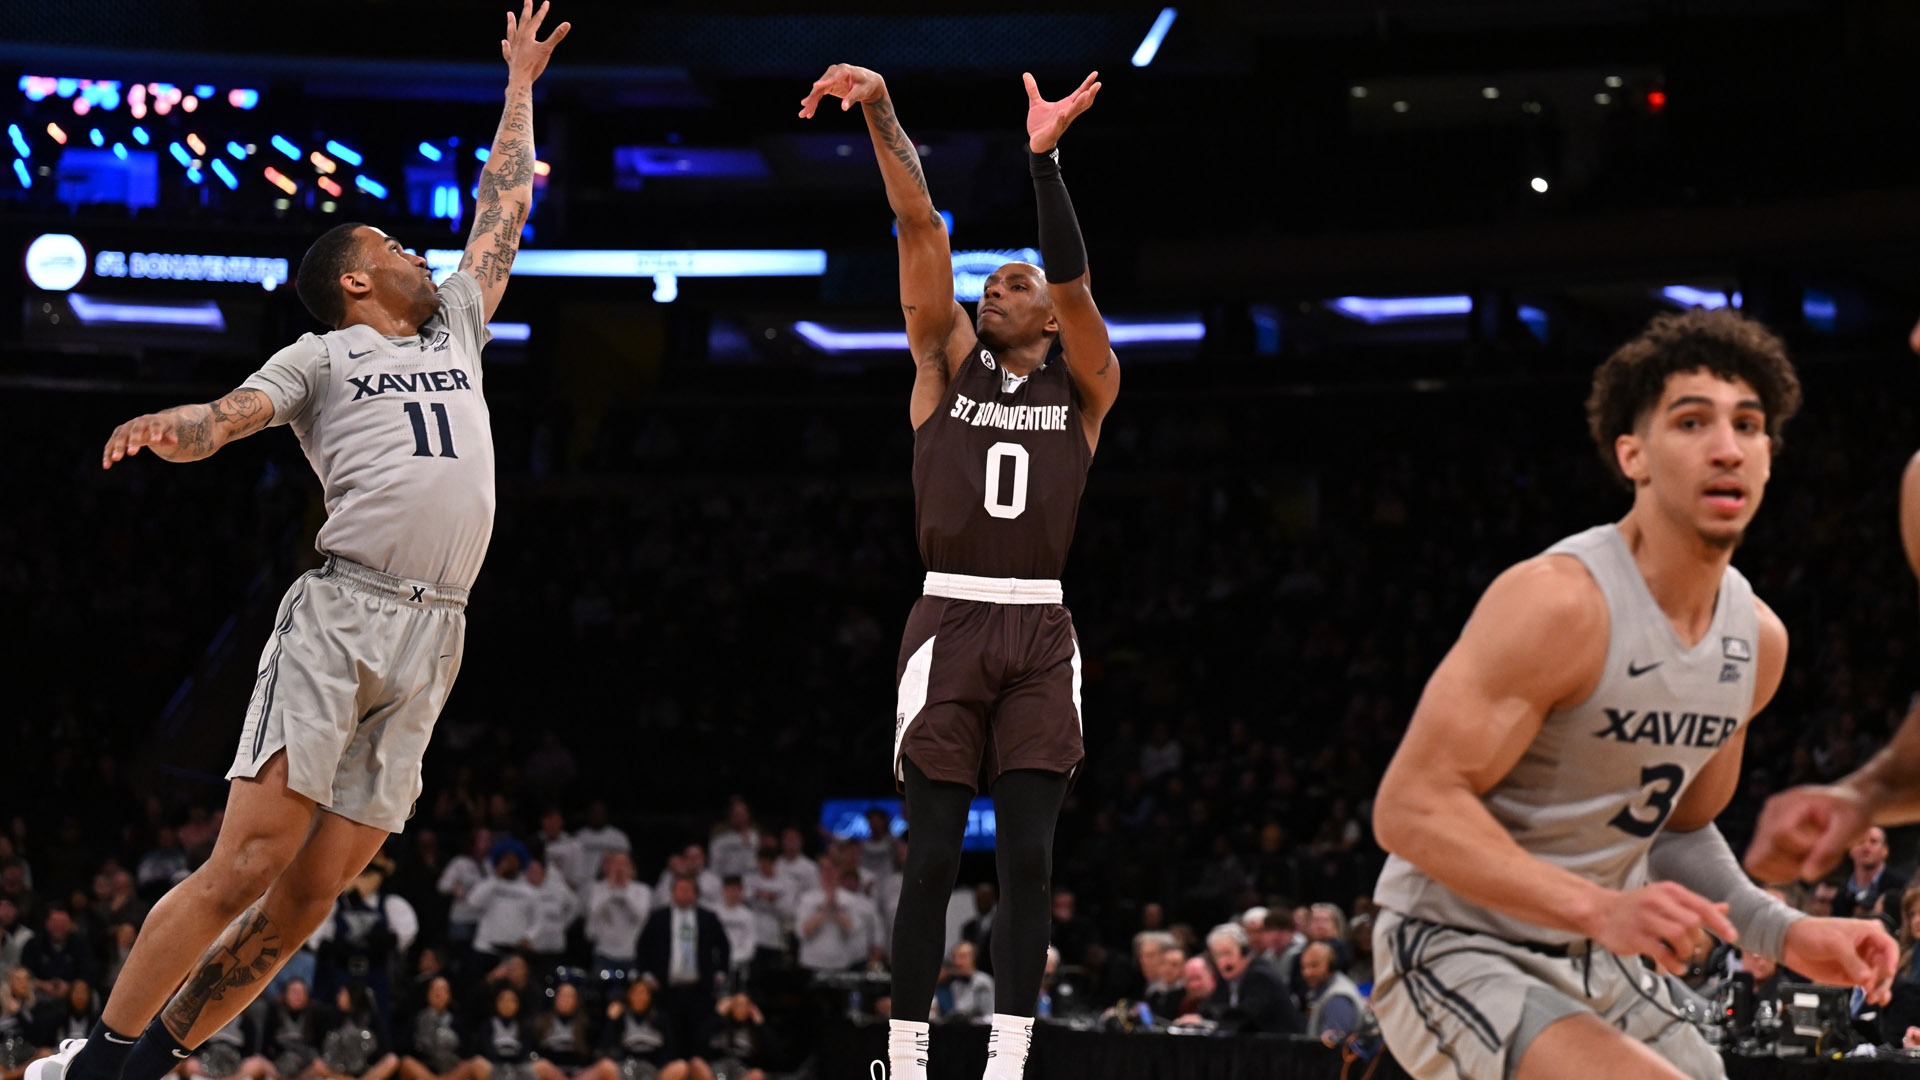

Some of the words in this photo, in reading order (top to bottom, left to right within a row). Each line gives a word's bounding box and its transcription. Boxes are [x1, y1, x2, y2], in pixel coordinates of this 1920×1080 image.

[346, 368, 471, 401] XAVIER
[403, 402, 459, 459] 11
[950, 394, 976, 423] ST.
[971, 401, 1069, 431] BONAVENTURE
[984, 441, 1029, 519] 0
[1593, 707, 1738, 748] XAVIER
[1606, 763, 1685, 838] 3
